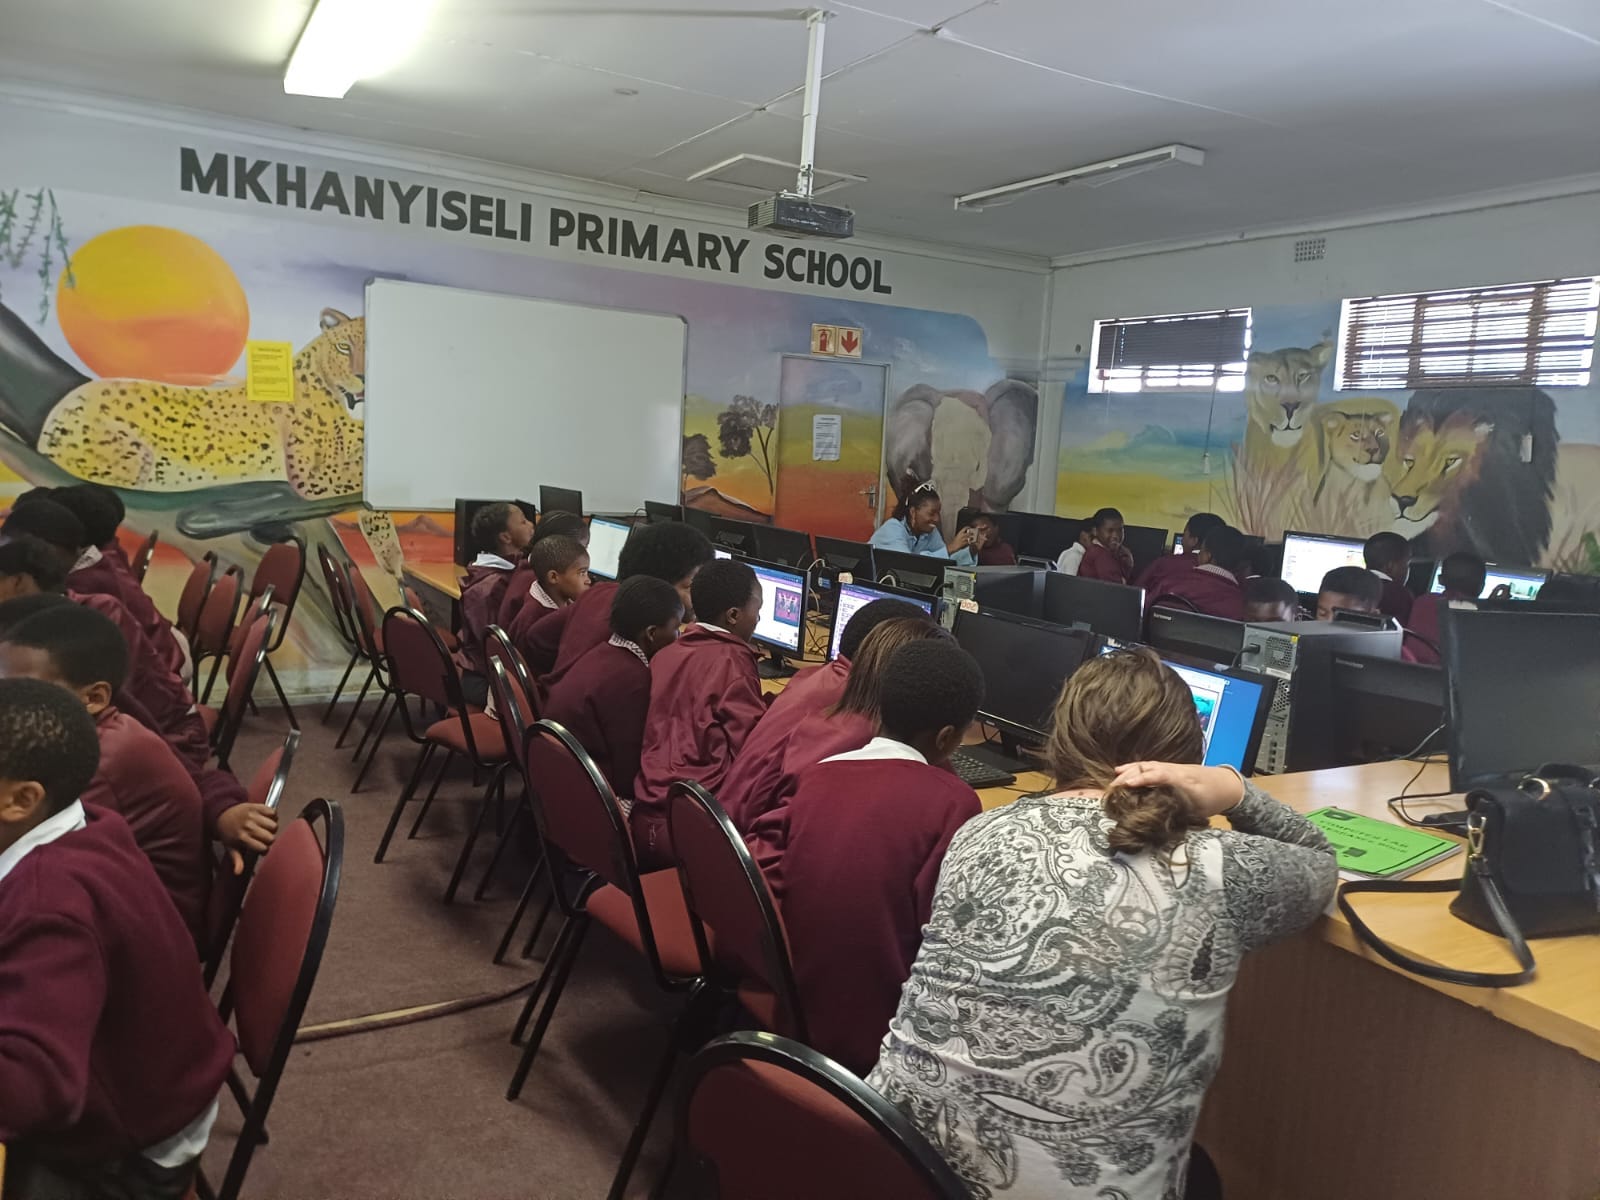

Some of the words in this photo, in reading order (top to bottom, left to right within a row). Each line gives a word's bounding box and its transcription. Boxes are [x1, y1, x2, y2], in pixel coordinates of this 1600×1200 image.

[180, 146, 532, 242] MKHANYISELI
[549, 207, 751, 274] PRIMARY
[763, 243, 892, 294] SCHOOL
